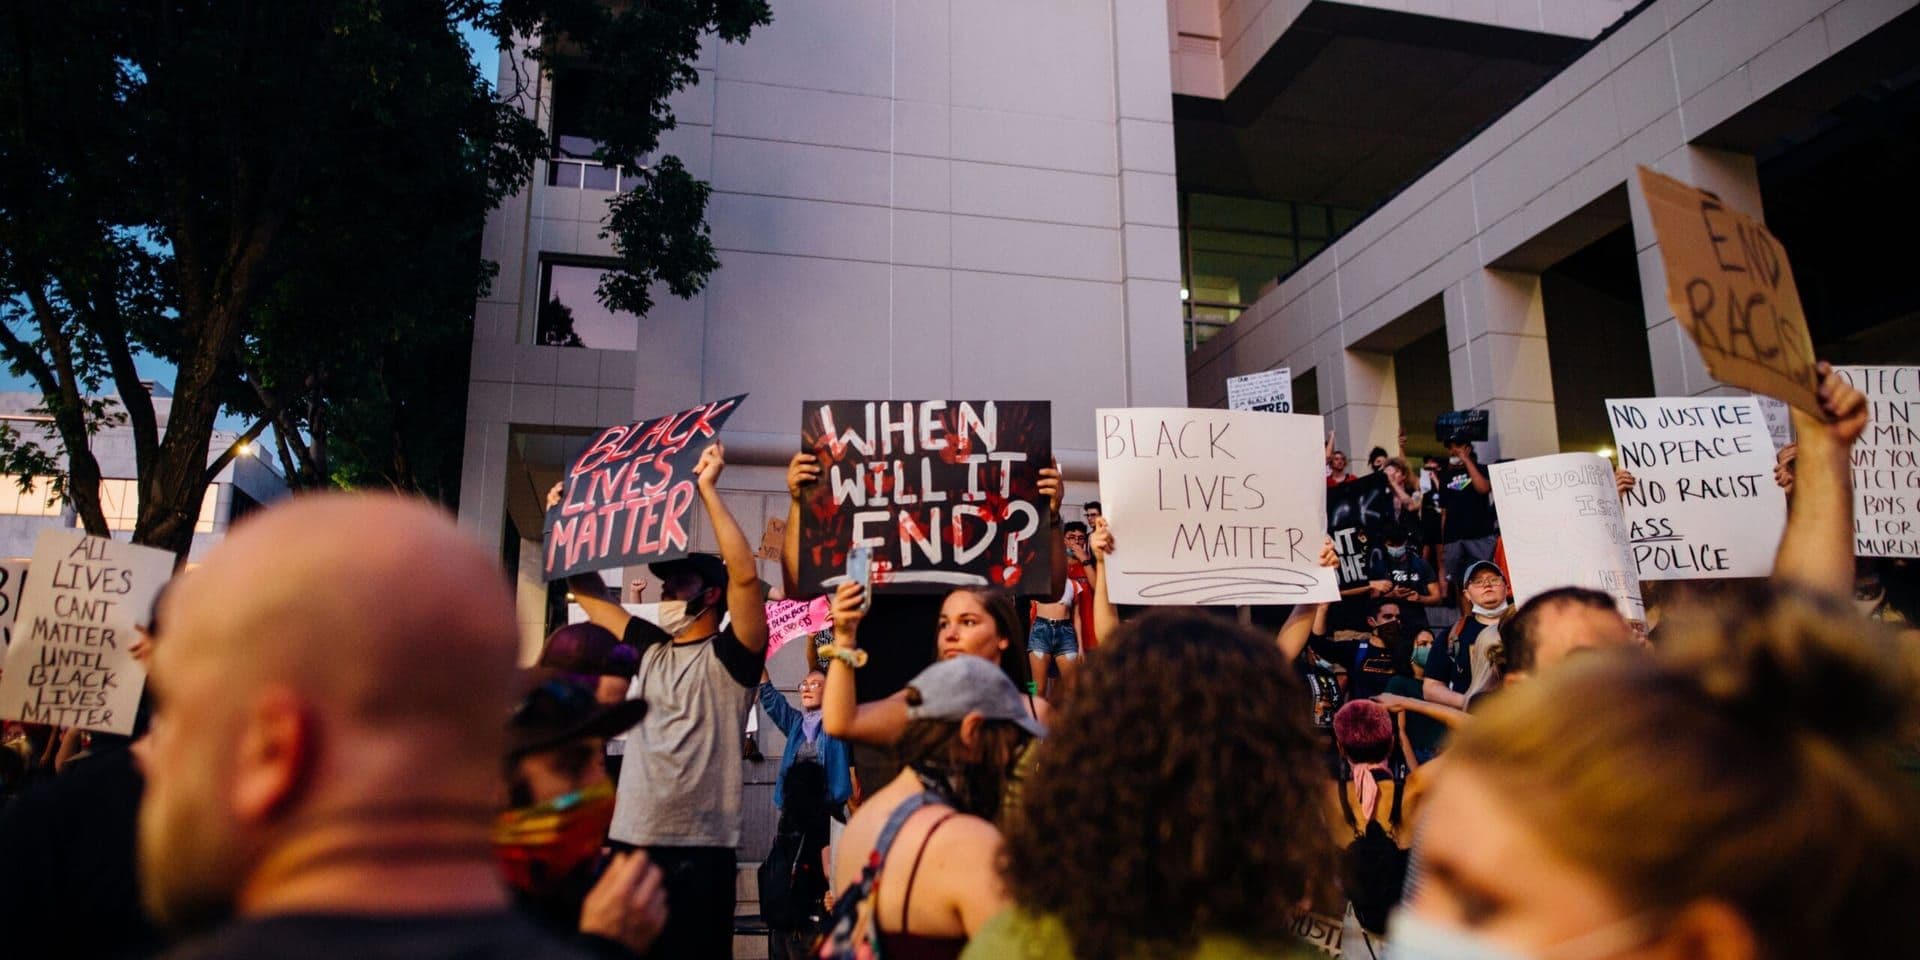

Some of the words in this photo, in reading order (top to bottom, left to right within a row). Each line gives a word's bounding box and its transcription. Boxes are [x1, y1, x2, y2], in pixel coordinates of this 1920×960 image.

[1701, 198, 1781, 291] END
[820, 400, 998, 458] WHEN
[1612, 404, 1647, 430] NO
[1658, 405, 1753, 430] JUSTICE
[570, 400, 735, 478] BLACK
[1103, 414, 1236, 460] BLACK
[1621, 442, 1657, 469] NO
[1660, 435, 1752, 466] PEACE
[562, 446, 677, 517] LIVES
[830, 456, 948, 507] WILL
[956, 451, 1028, 501] IT
[1158, 468, 1266, 512] LIVES
[1626, 478, 1666, 508] NO
[1677, 474, 1763, 502] RACIST
[1864, 494, 1906, 516] BOYS
[546, 480, 694, 572] MATTER
[851, 500, 1040, 585] END?
[1171, 522, 1312, 563] MATTER
[1630, 518, 1674, 540] ASS
[70, 537, 113, 561] ALL
[1633, 544, 1730, 575] POLICE
[52, 559, 133, 595] LIVES
[54, 595, 117, 623] CANT
[31, 615, 117, 649] MATTER
[41, 645, 110, 671] UNTIL
[28, 664, 117, 689] BLACK
[37, 687, 107, 707] LIVES
[21, 703, 113, 726] MATTER
